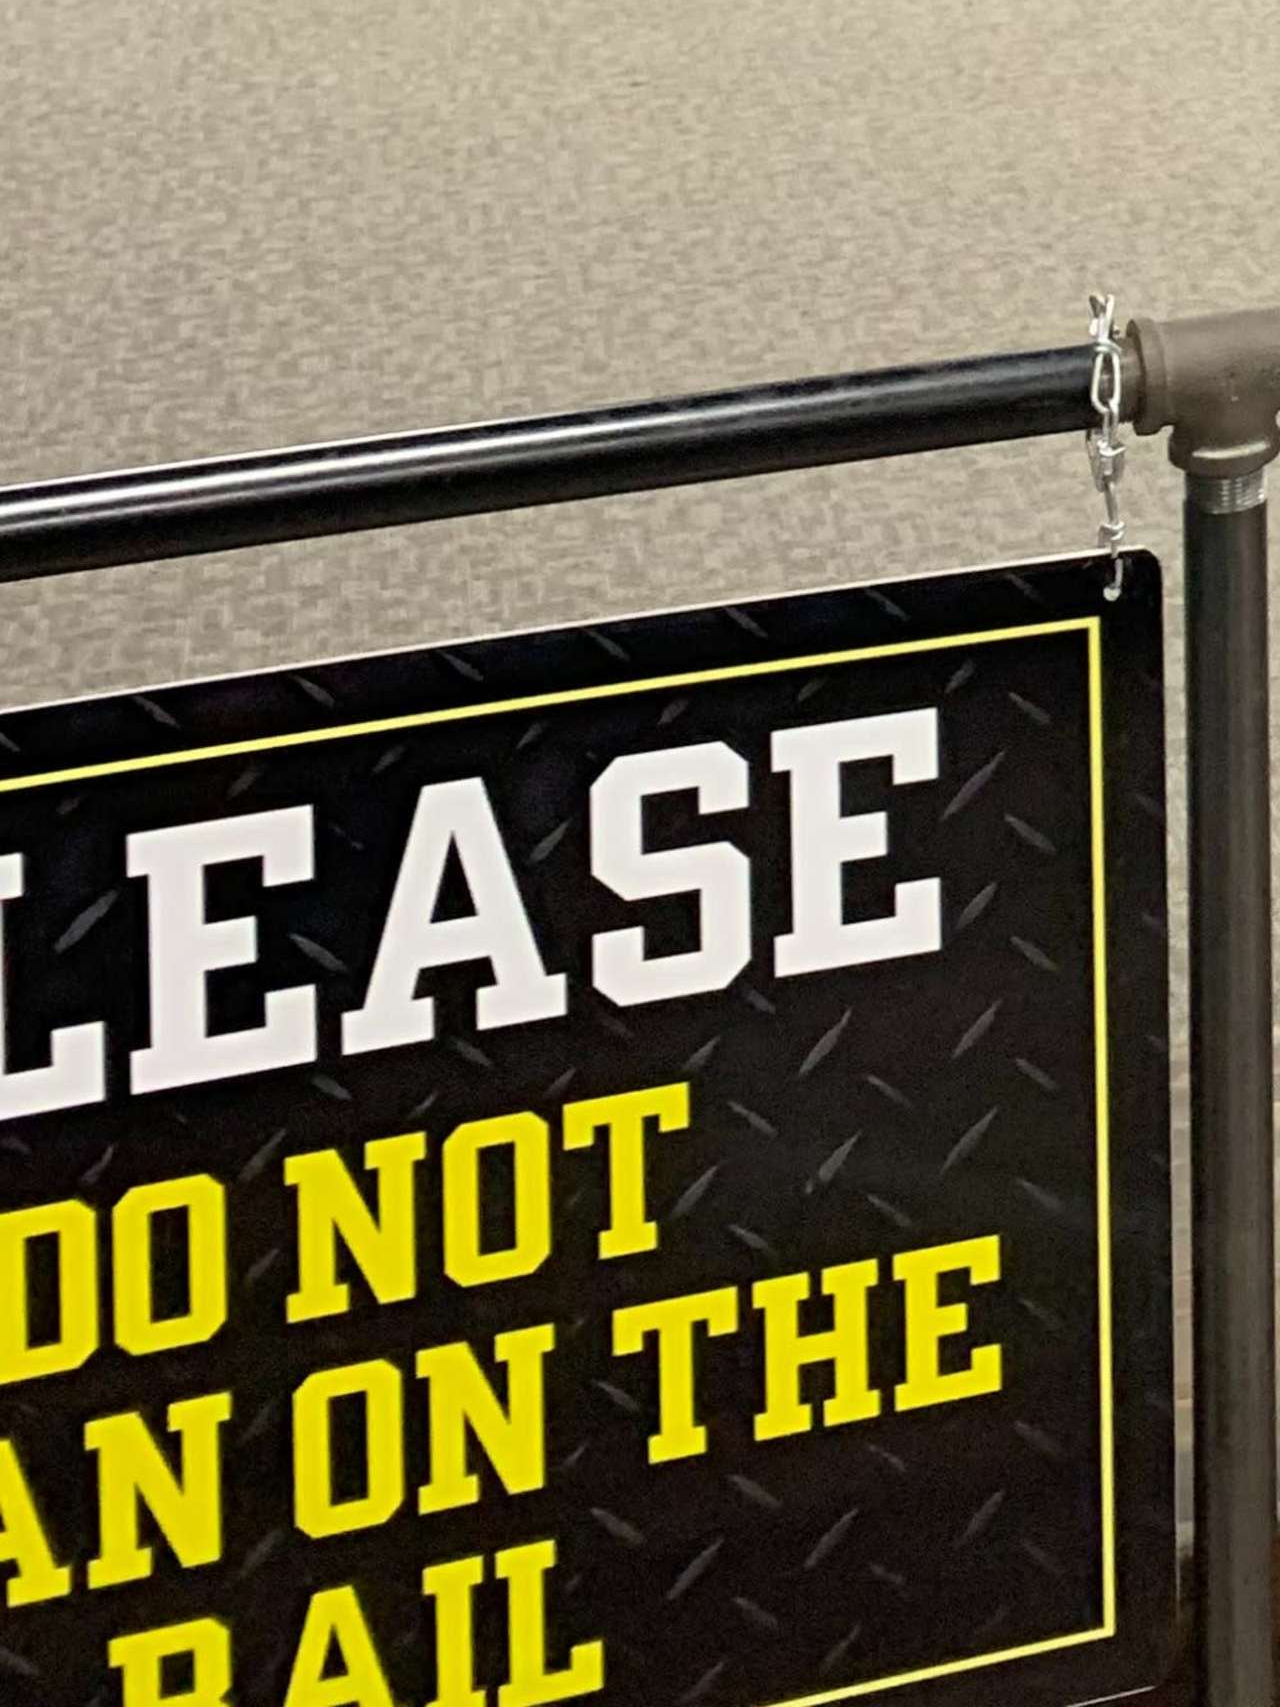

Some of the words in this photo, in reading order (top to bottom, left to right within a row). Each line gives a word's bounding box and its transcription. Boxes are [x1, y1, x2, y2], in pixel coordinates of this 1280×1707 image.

[0, 1173, 228, 1384] DO
[284, 1081, 692, 1326] NOT
[291, 1323, 556, 1539] ON
[611, 1232, 1001, 1467] THE
[107, 1539, 603, 1707] RAIL
